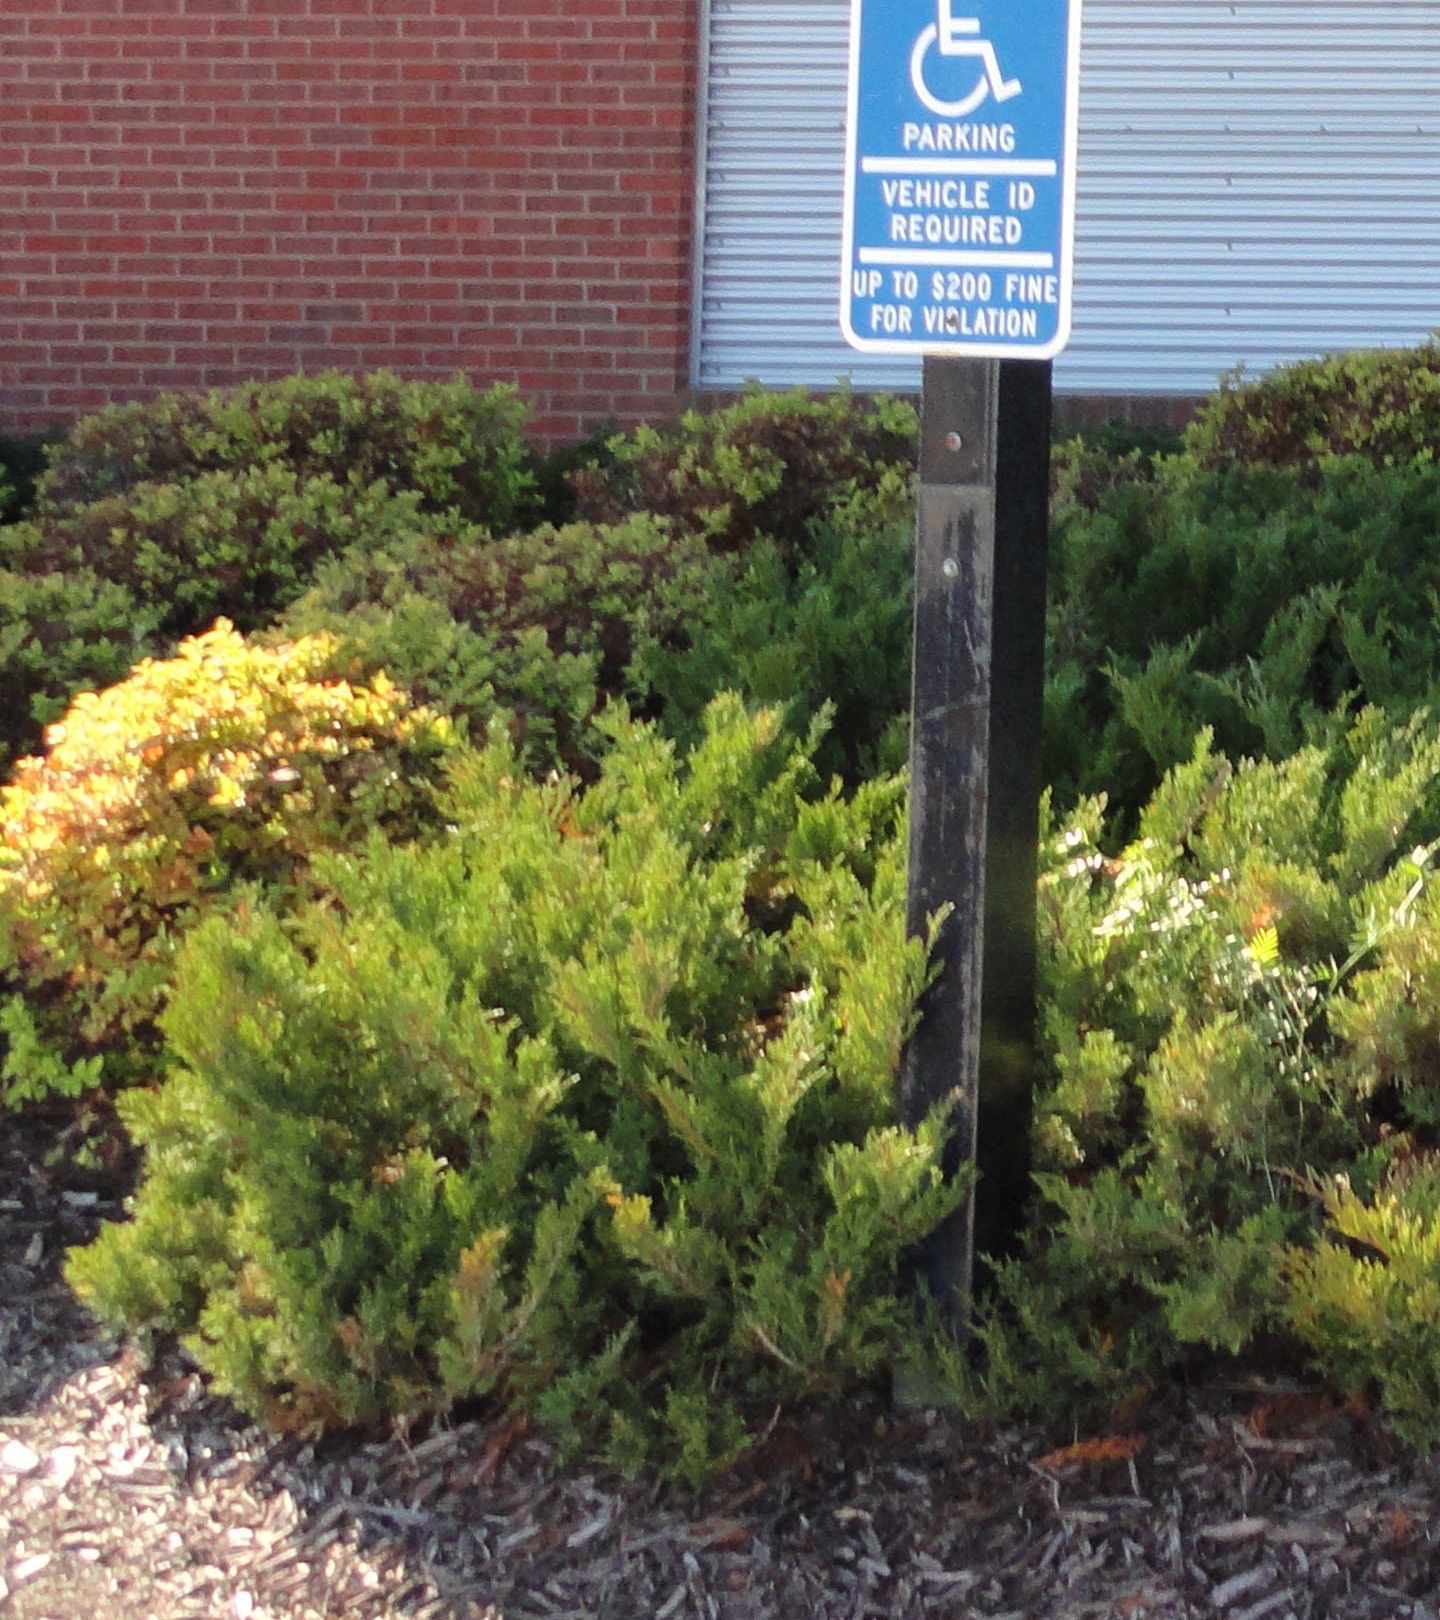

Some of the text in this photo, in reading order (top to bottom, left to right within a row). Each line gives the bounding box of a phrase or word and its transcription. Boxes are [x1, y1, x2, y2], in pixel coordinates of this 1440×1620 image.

[903, 123, 1015, 151] PARKING
[882, 180, 1035, 209] VEHICLE ID
[891, 214, 1022, 244] REQUIRED
[854, 270, 1057, 303] UP TO $200 FINE
[871, 304, 1036, 337] FOR VIOLATION
